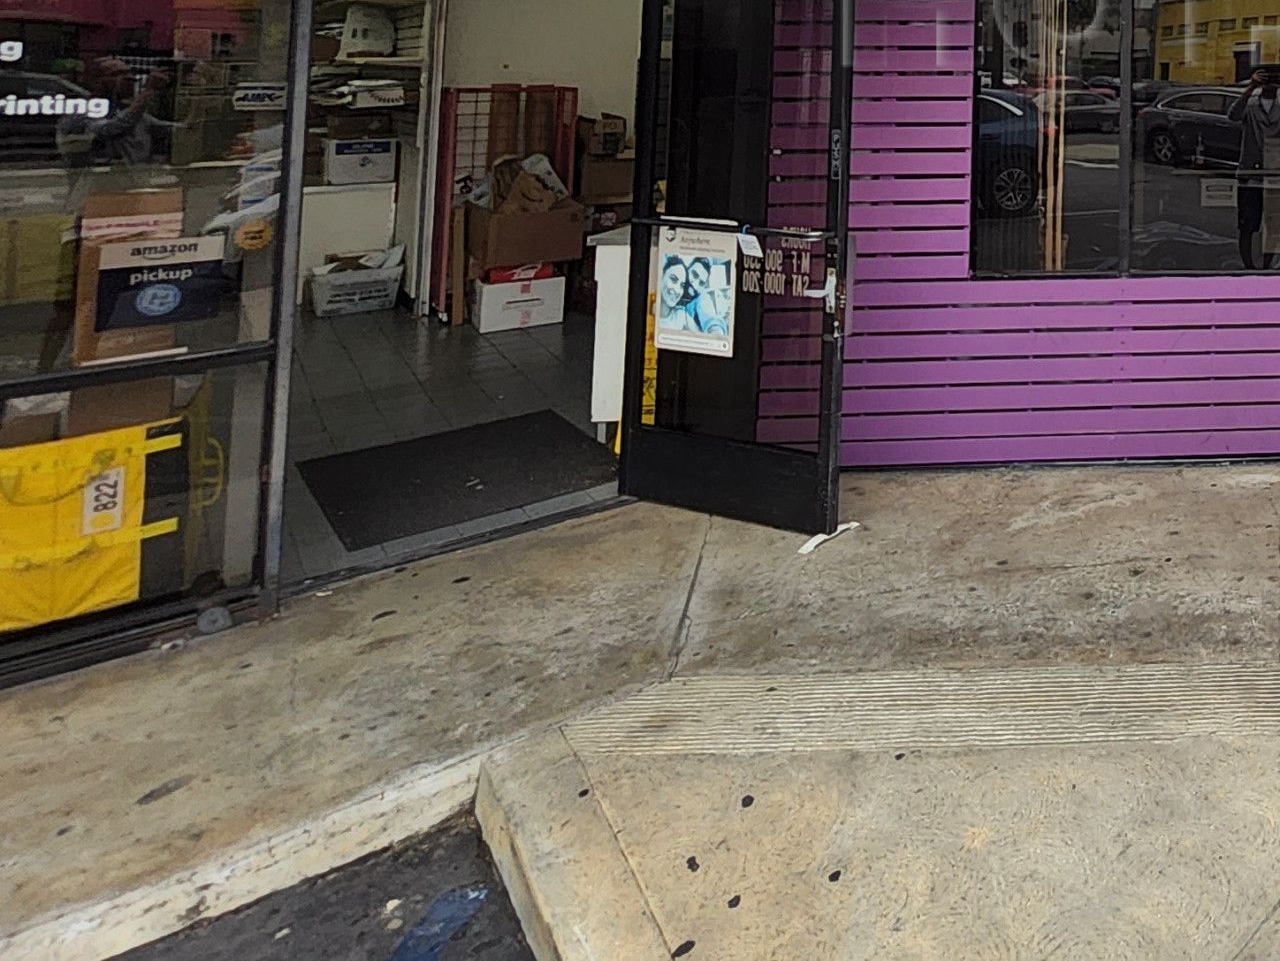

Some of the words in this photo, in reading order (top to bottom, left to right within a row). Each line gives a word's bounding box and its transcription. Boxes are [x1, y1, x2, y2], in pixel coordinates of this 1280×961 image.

[130, 242, 199, 257] amazon
[129, 268, 193, 286] pickup
[93, 479, 119, 513] 822
